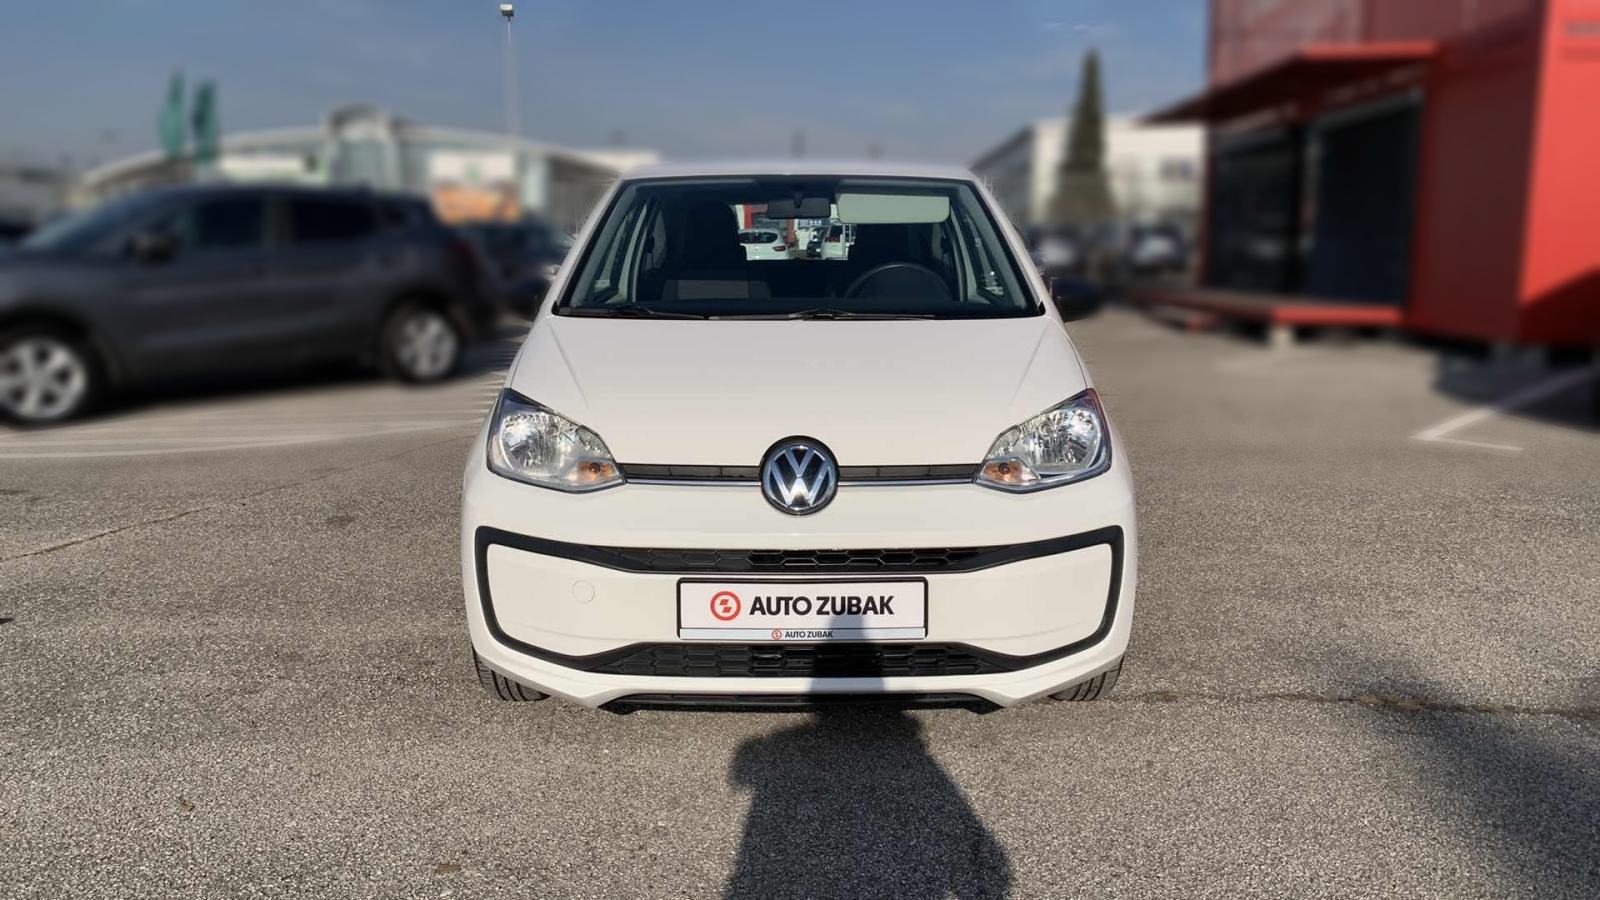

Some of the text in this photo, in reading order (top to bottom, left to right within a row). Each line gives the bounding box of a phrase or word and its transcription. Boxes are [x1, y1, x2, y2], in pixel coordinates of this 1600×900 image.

[749, 596, 895, 616] AUTO ZUBAK
[784, 631, 833, 639] AUTO ZUBAK
